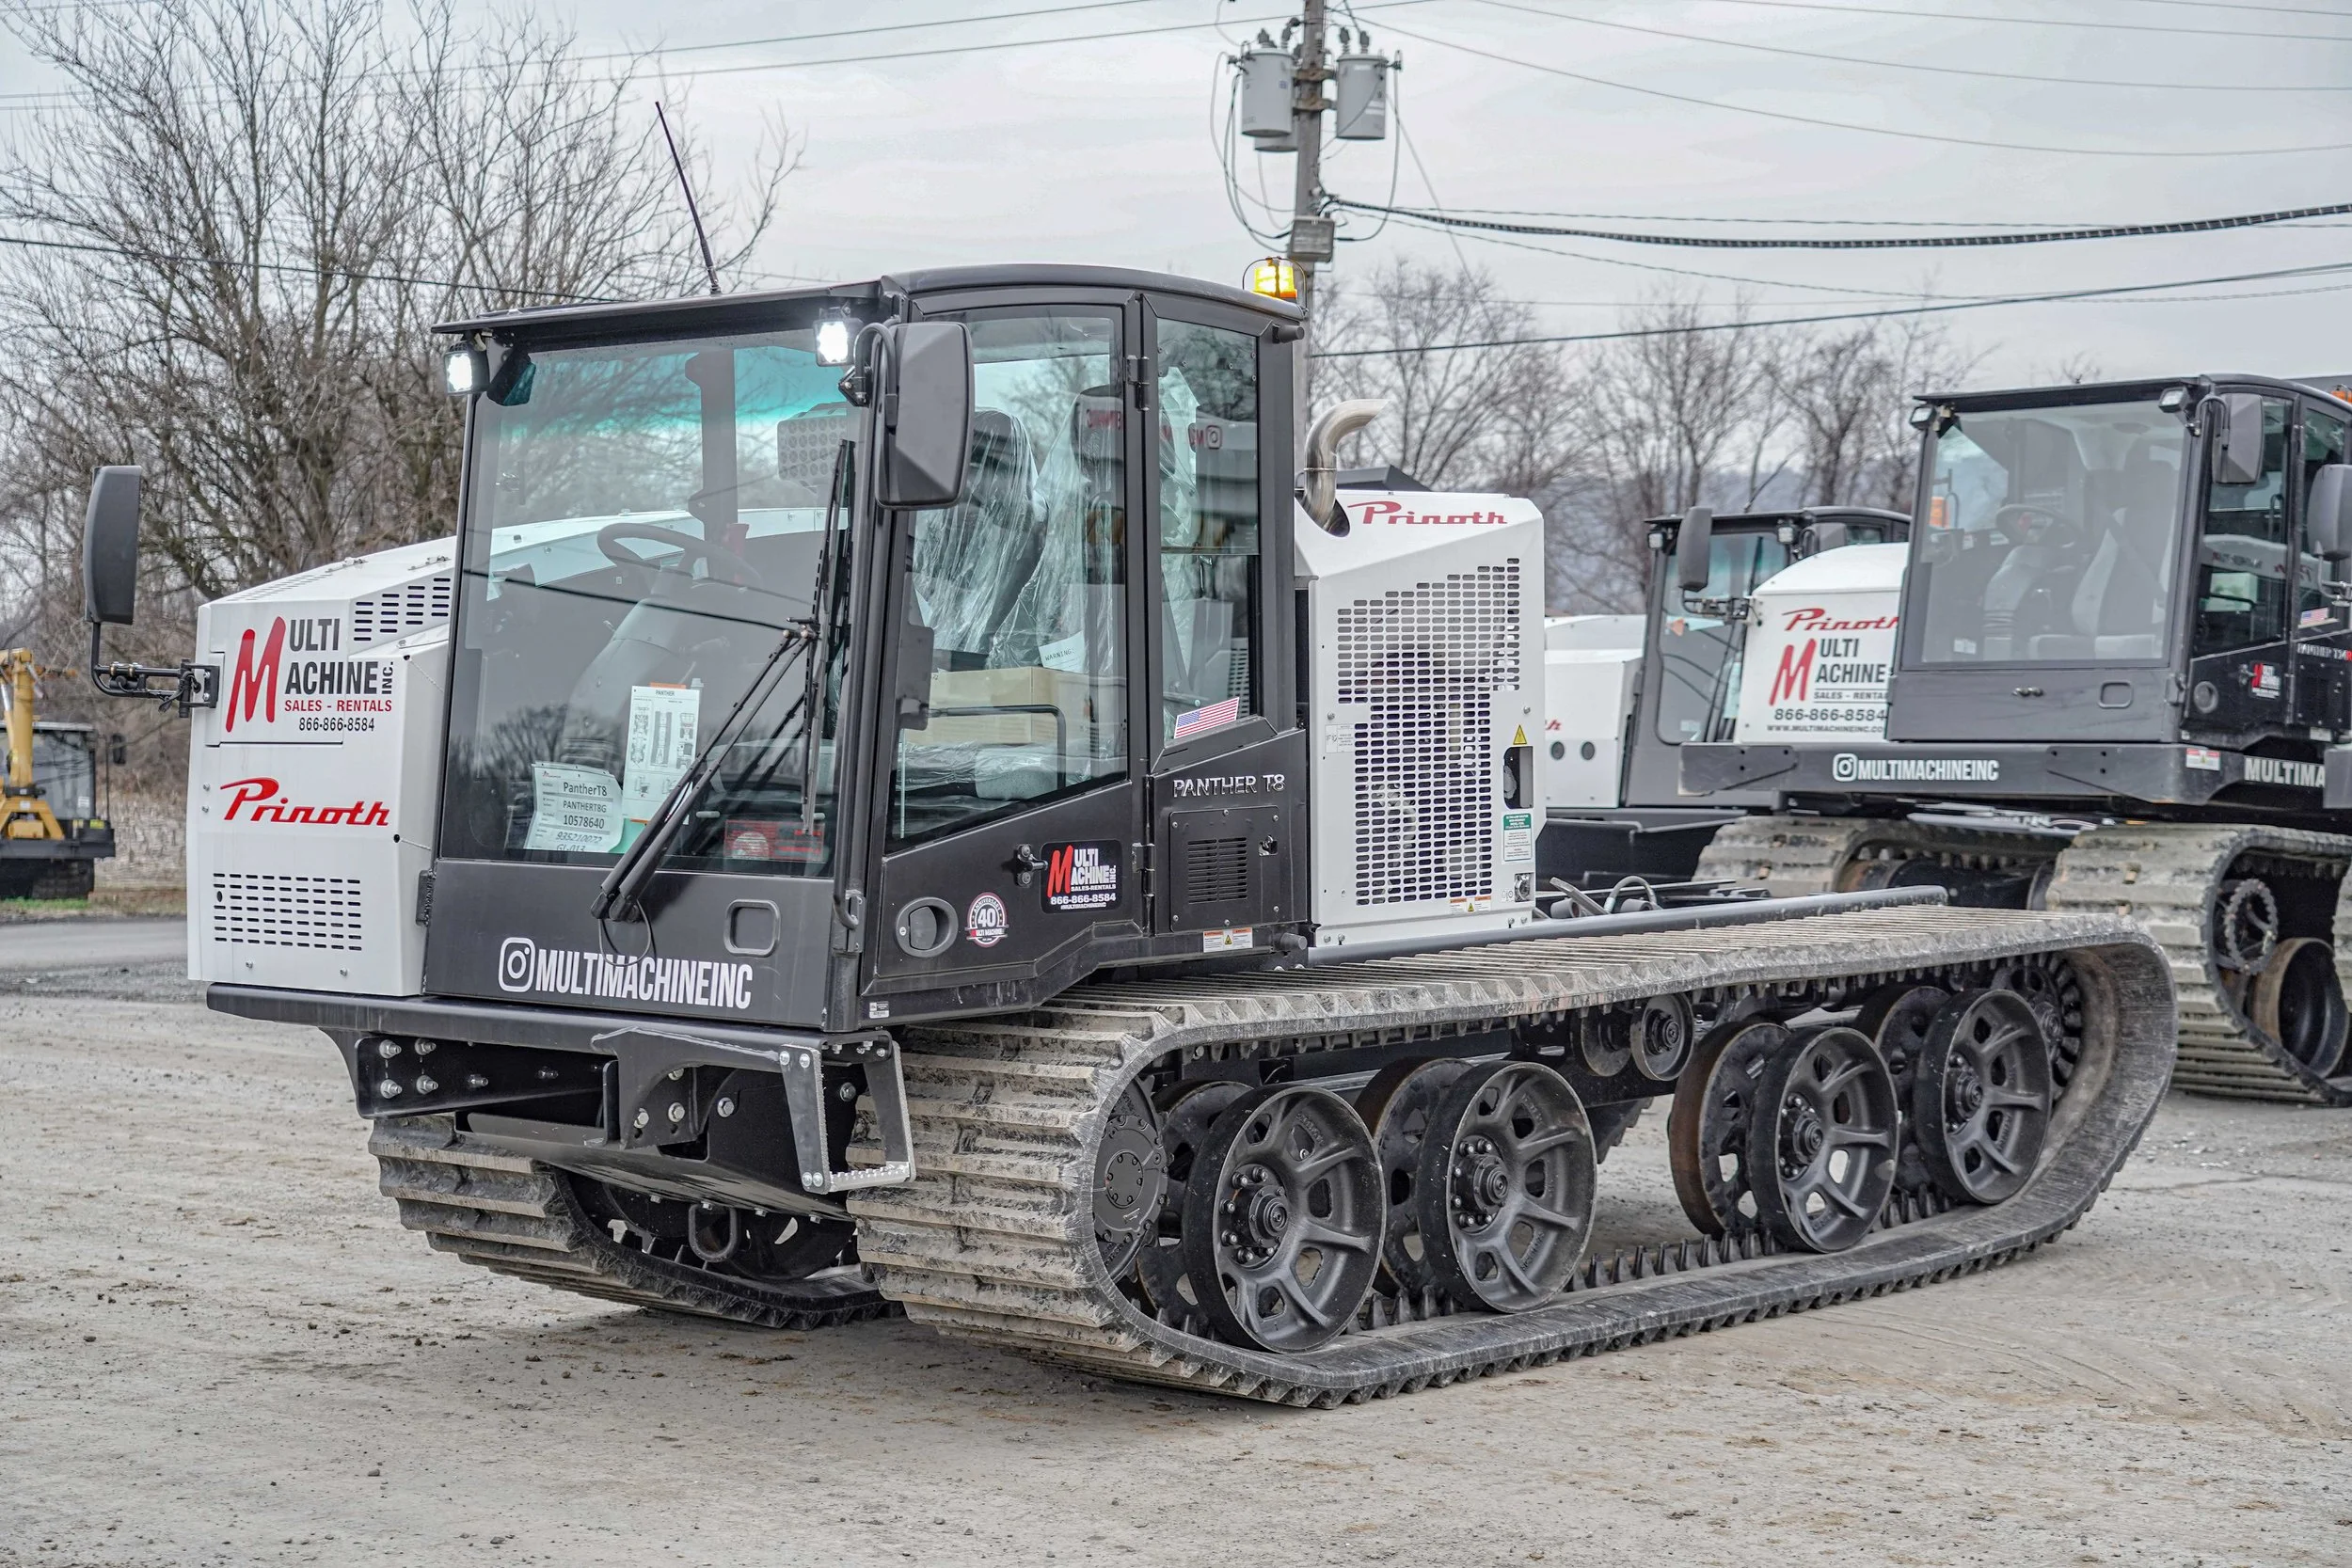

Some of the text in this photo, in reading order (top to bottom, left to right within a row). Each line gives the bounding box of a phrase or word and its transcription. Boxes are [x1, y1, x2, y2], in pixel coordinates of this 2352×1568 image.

[1347, 500, 1507, 525] Prinoth
[382, 661, 393, 694] INC.
[1814, 691, 1843, 700] SALES
[284, 700, 322, 712] SALES
[337, 700, 392, 712] RENTALS
[1774, 708, 1888, 721] 866-866-8584
[1858, 759, 1999, 781] MULTIMACHINEINC
[563, 782, 608, 797] PantherT8
[1173, 773, 1285, 798] PANTHER T8
[219, 777, 390, 826] Prinoth
[564, 815, 605, 829] 10578640
[1050, 893, 1117, 905] 866-866-8584
[977, 908, 996, 927] 40
[535, 949, 754, 1009] MULTIMACHINEINC
